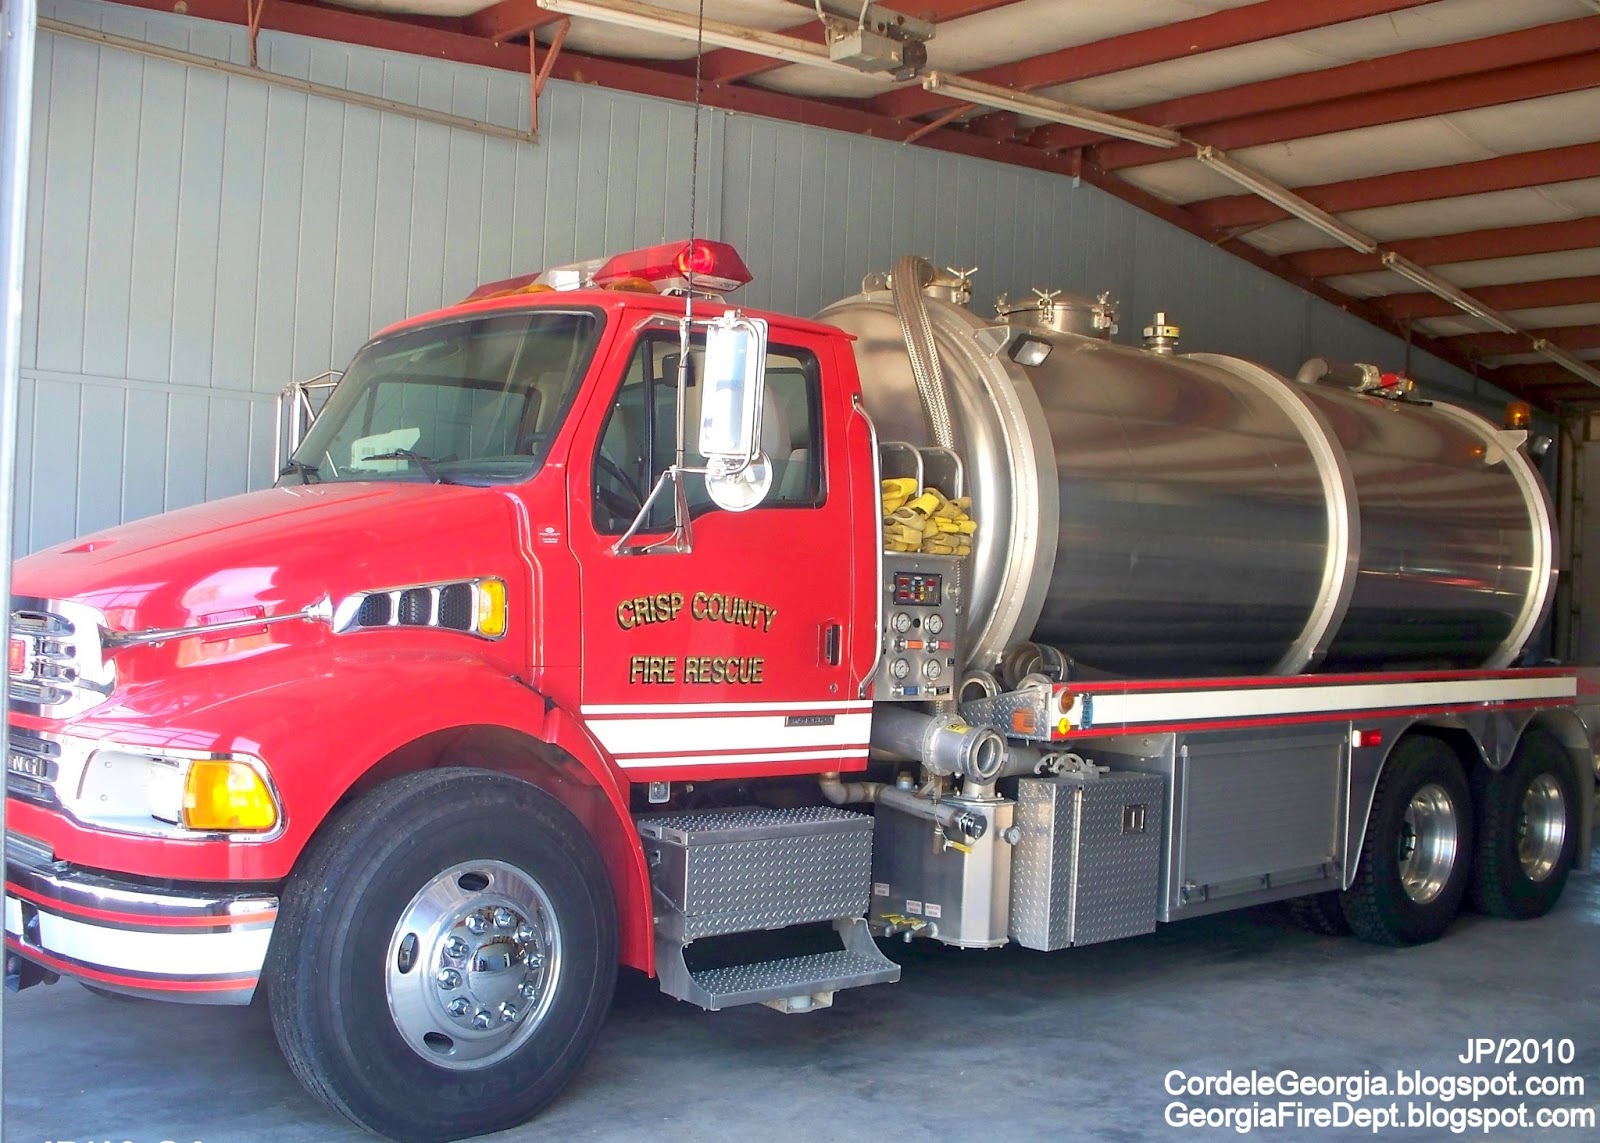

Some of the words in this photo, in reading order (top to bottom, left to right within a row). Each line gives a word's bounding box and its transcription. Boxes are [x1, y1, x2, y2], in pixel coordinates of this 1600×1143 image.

[617, 592, 684, 630] CRISP
[691, 591, 777, 632] COUNTY
[630, 656, 676, 684] FIRE
[683, 656, 765, 684] RESCUE
